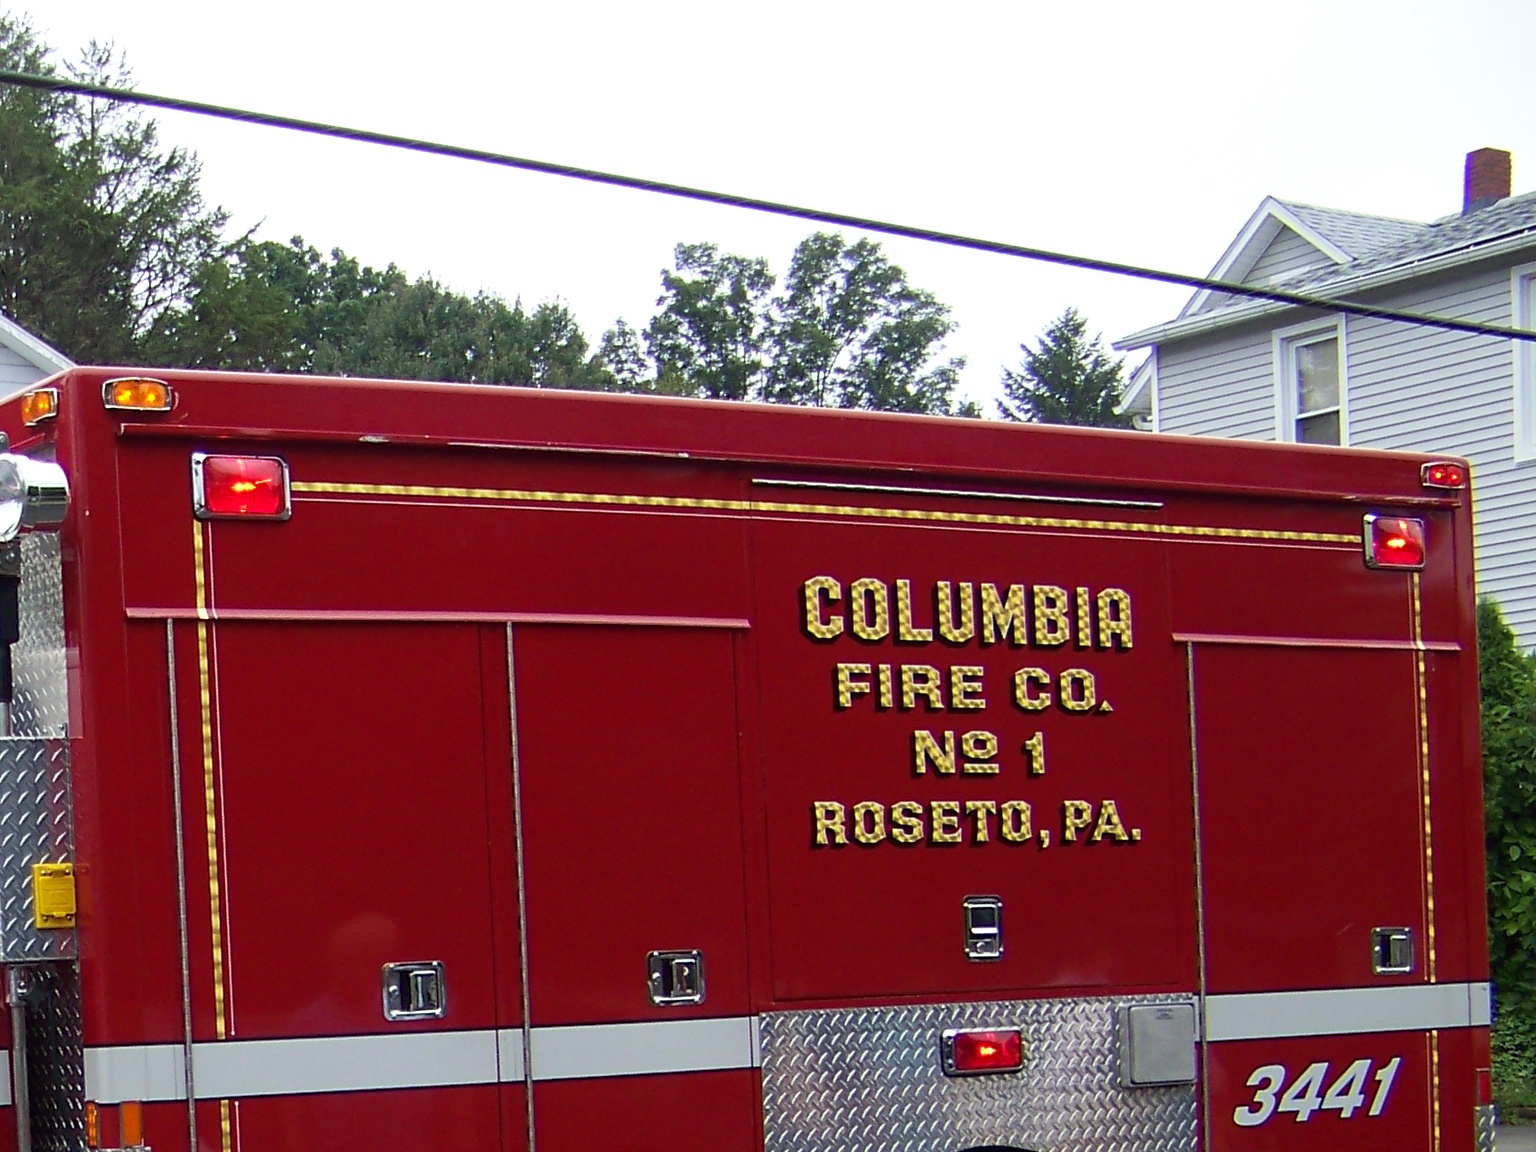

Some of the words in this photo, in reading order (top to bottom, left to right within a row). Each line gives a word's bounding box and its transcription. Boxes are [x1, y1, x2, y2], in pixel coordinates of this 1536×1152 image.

[803, 575, 1133, 648] COLUMBIA
[835, 662, 986, 709] FIRE
[1014, 667, 1114, 712] CO.
[1024, 731, 1046, 774] 1
[813, 800, 1051, 848] ROSETO,
[1063, 799, 1142, 842] PA.
[1232, 1056, 1402, 1127] 3441
